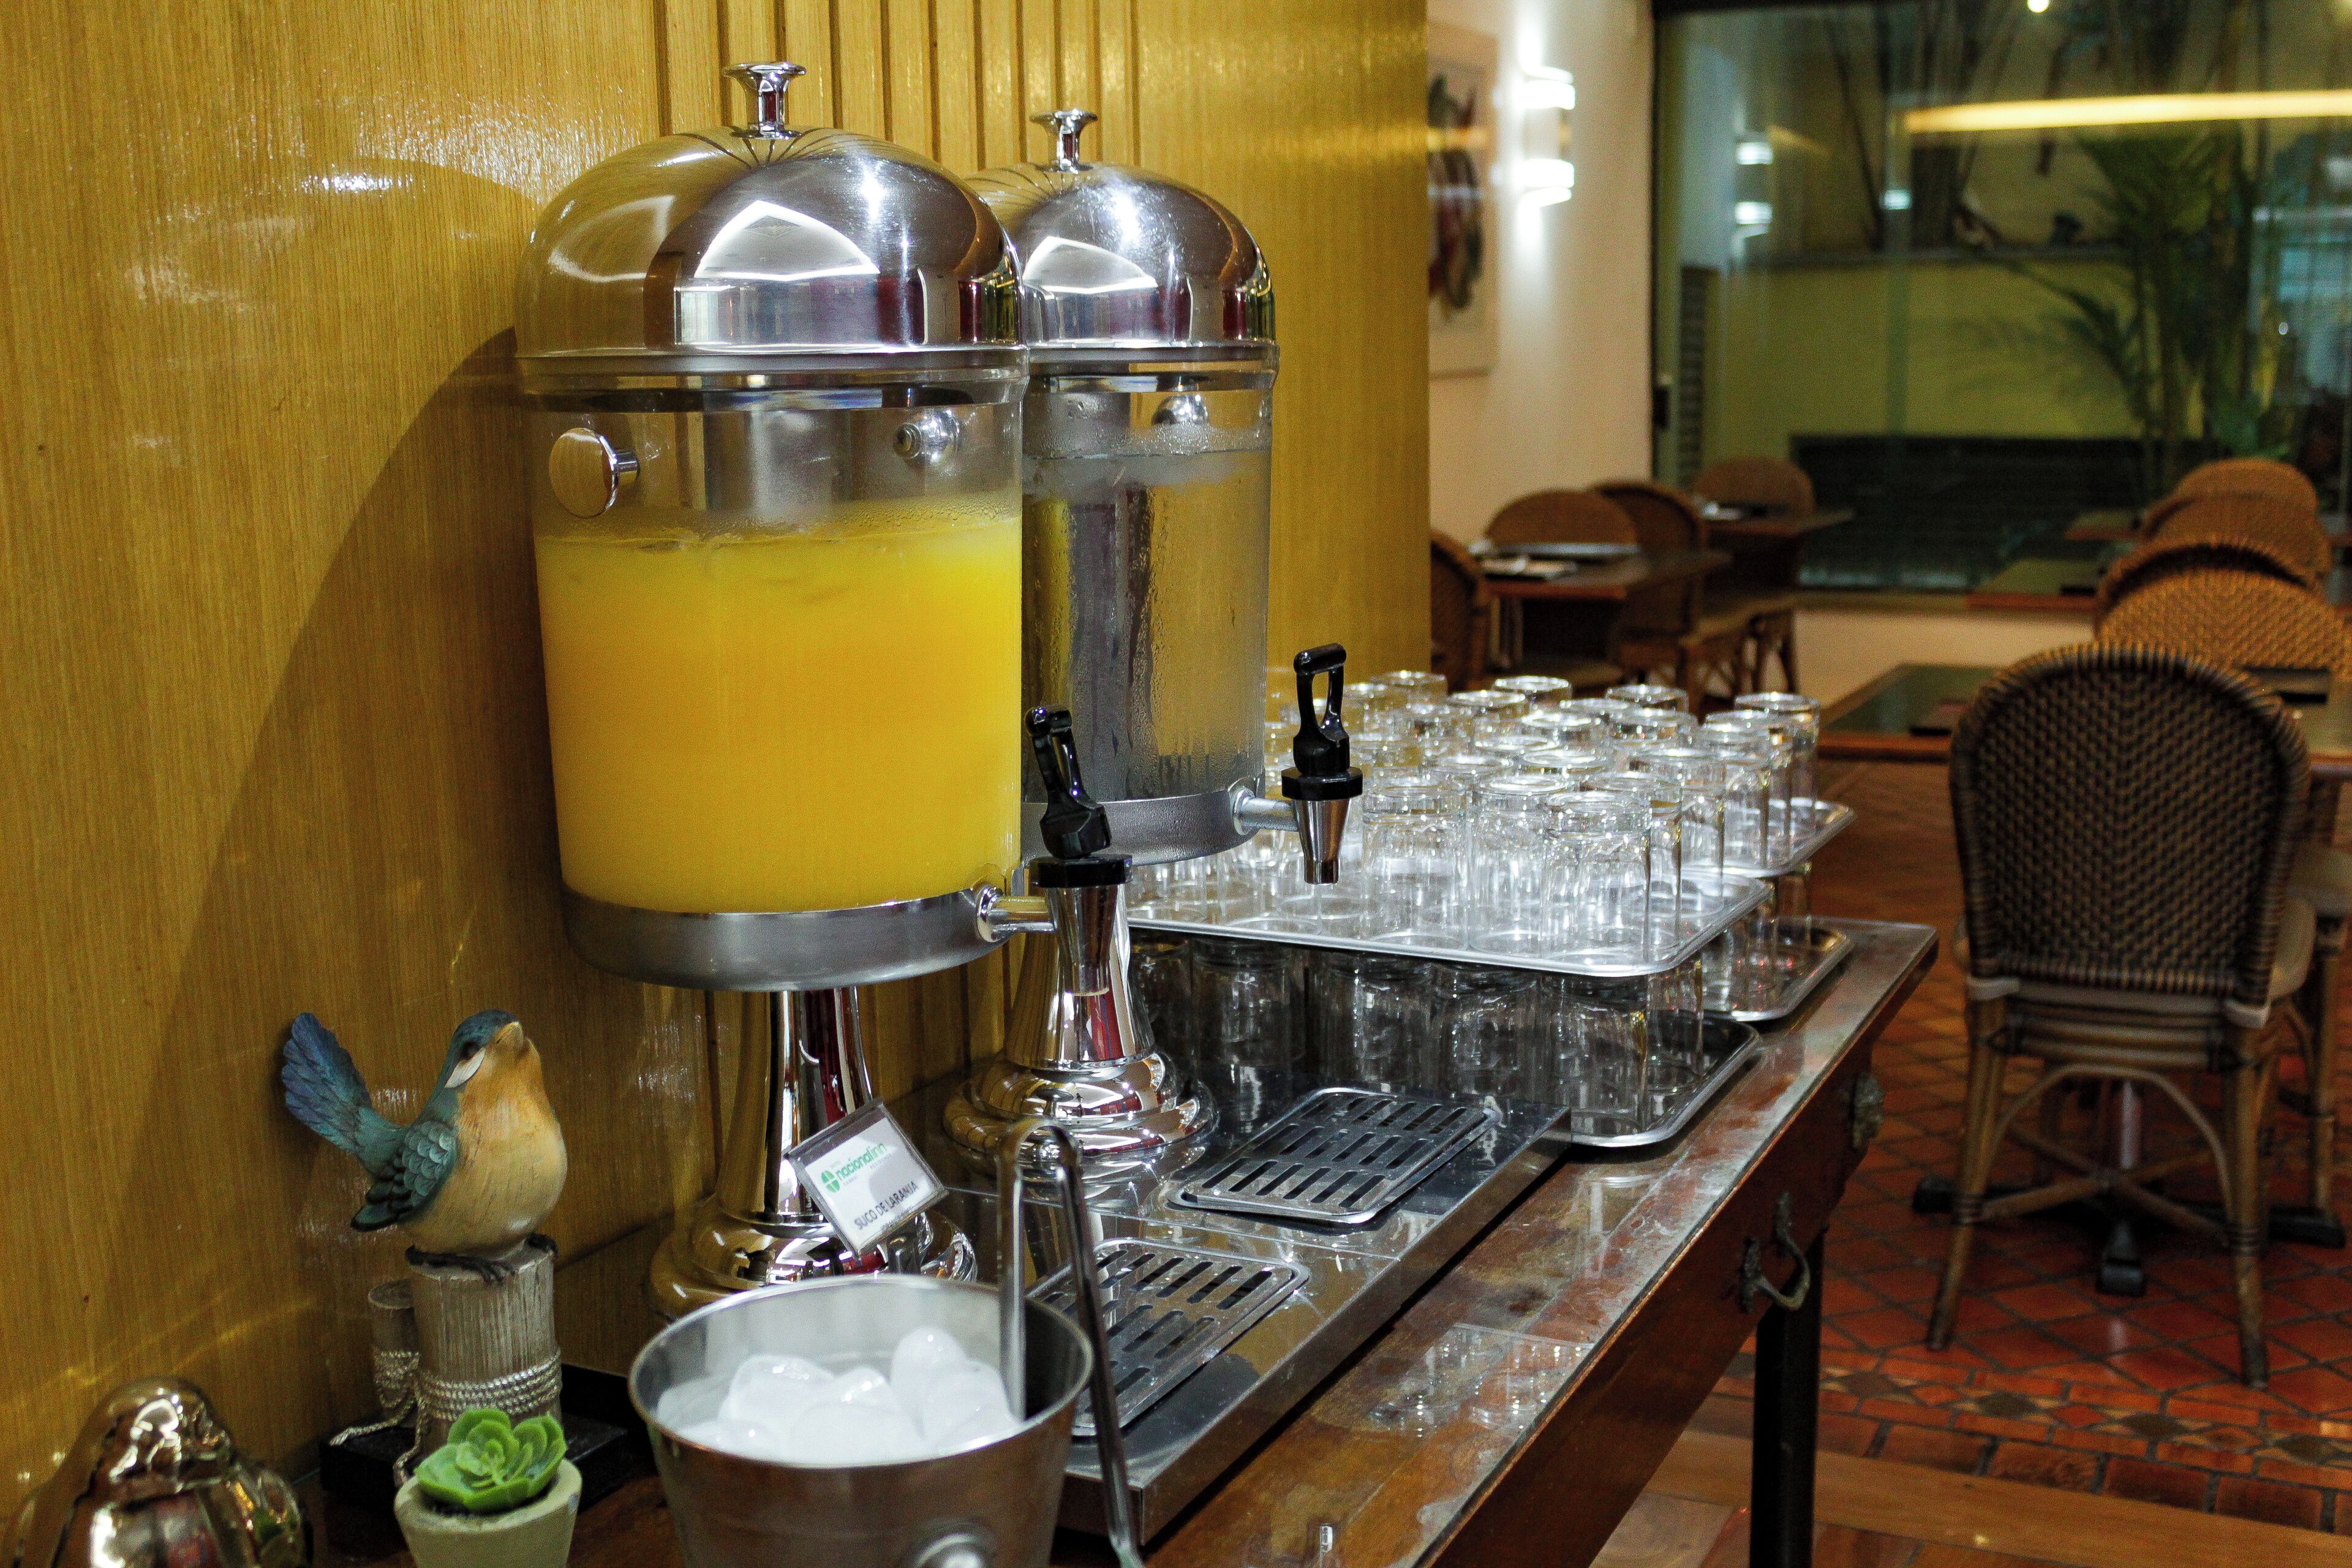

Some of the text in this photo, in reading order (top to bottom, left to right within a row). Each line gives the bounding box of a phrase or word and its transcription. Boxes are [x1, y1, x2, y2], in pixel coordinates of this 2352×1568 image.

[854, 1210, 878, 1230] SUCO
[875, 1202, 888, 1216] DE
[884, 1182, 919, 1209] LARANJA
